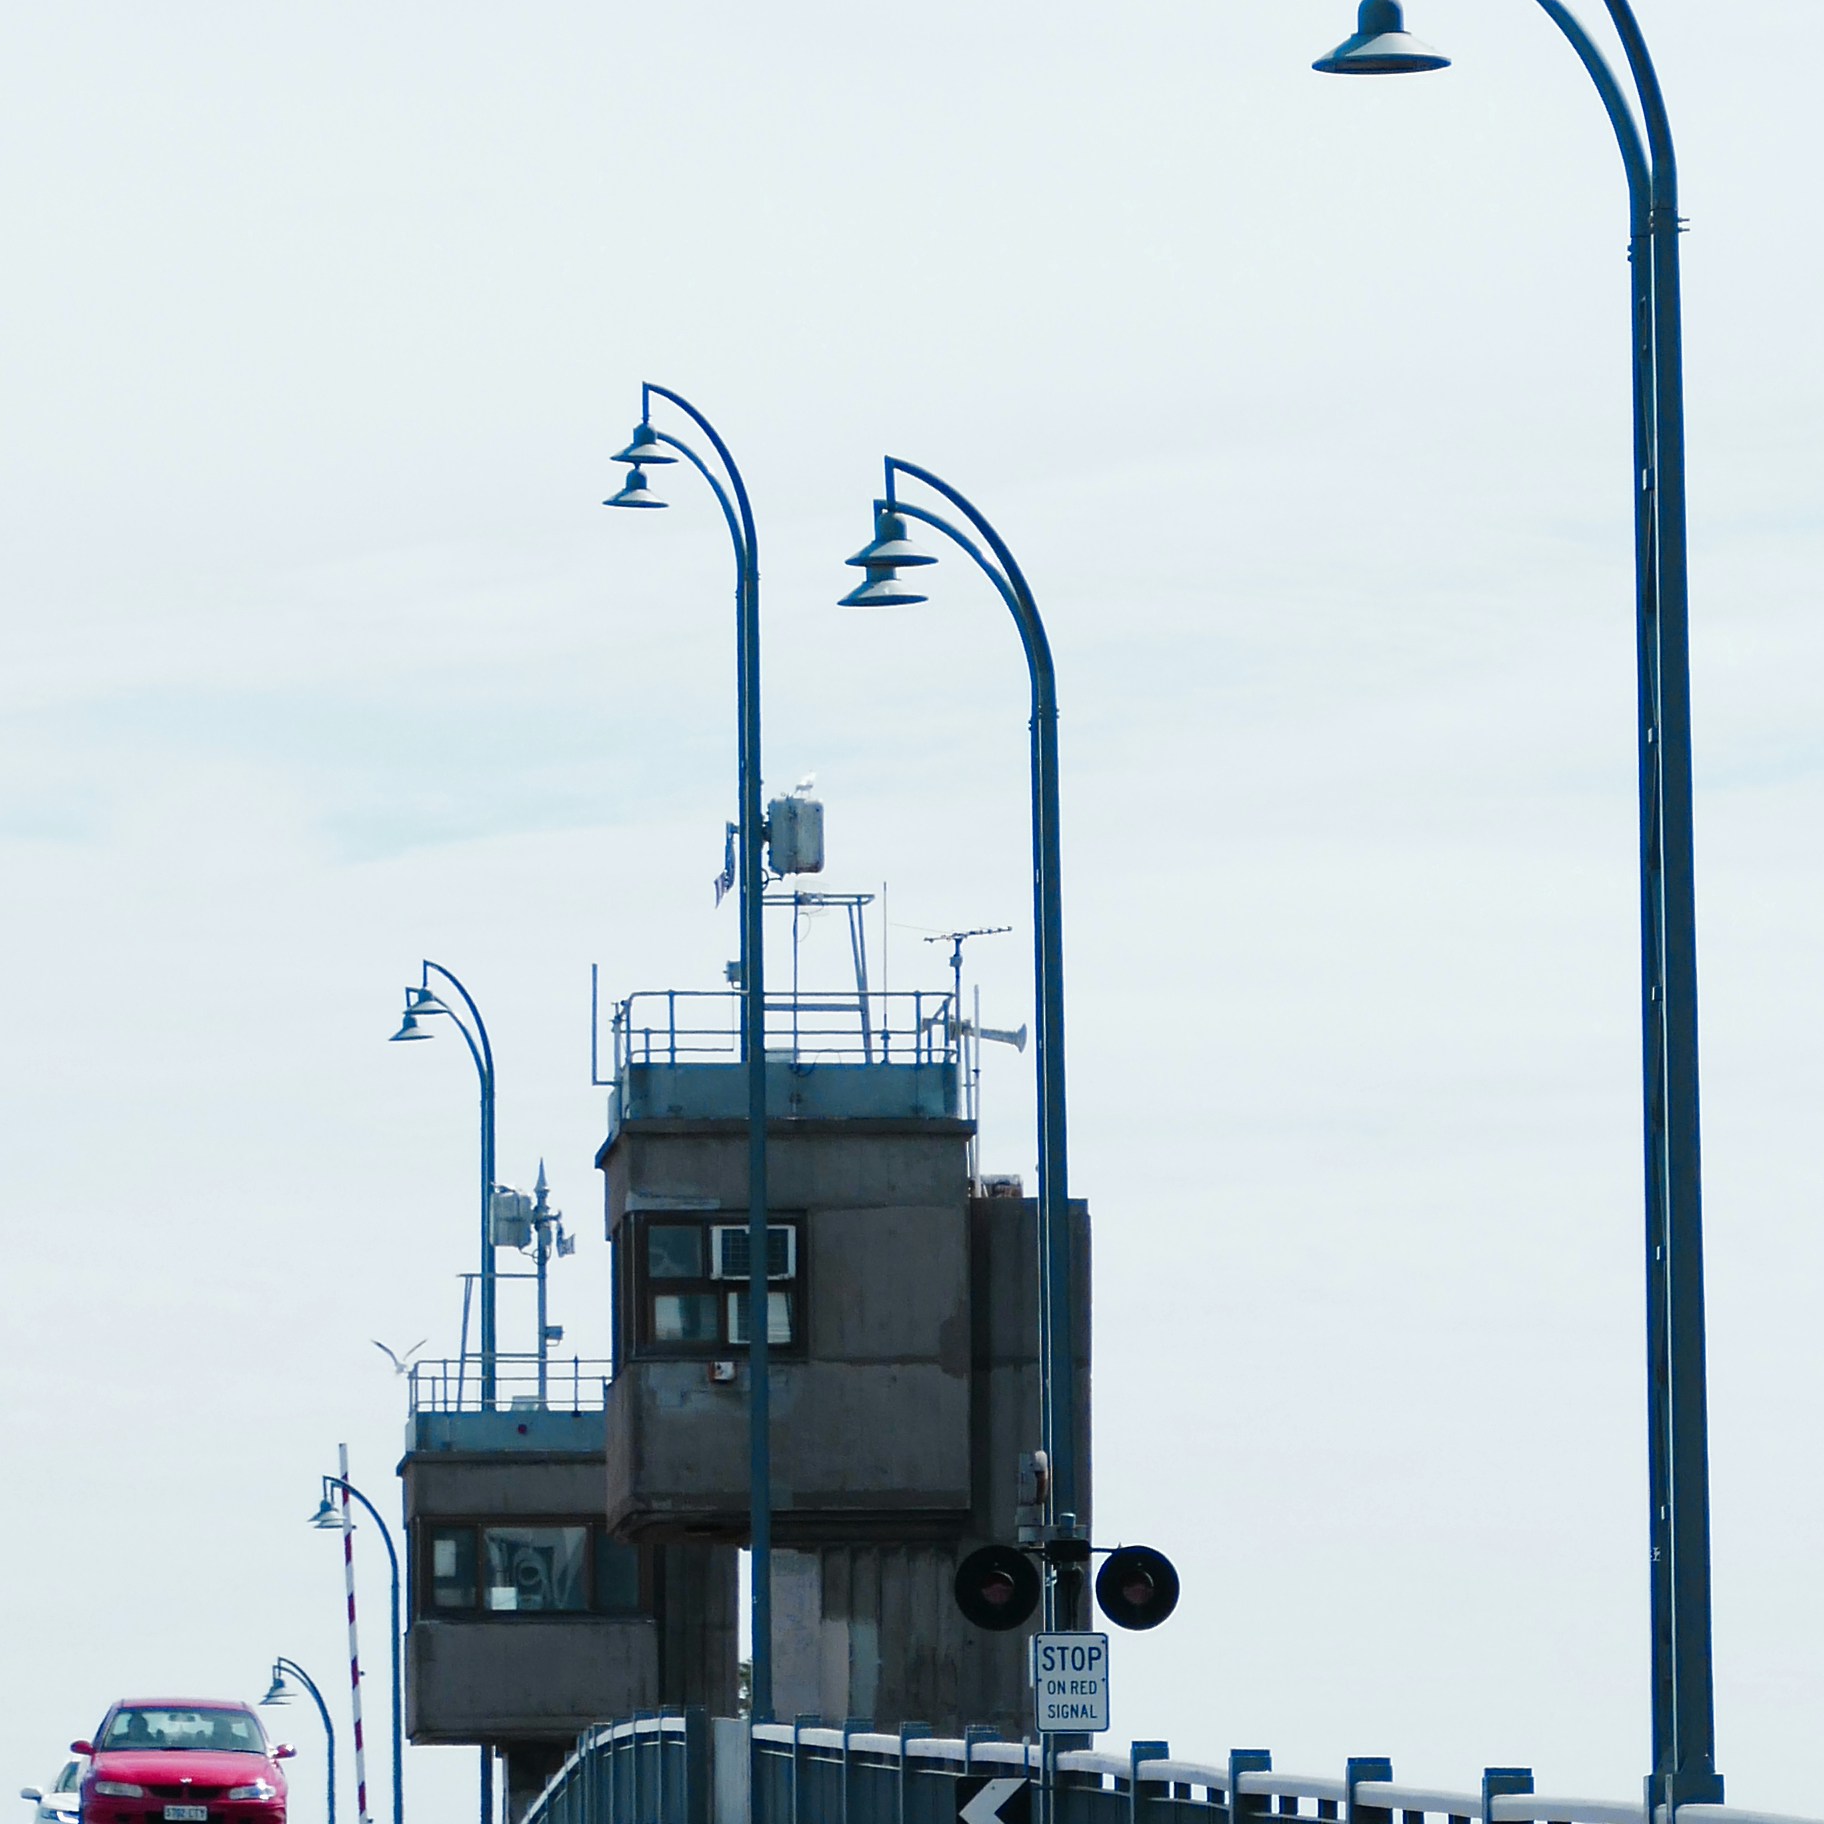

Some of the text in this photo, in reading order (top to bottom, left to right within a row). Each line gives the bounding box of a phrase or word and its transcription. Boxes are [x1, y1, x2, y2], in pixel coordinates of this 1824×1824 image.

[1042, 1646, 1102, 1671] STOP
[1047, 1680, 1097, 1695] ON RED
[1047, 1704, 1098, 1719] SIGNAL
